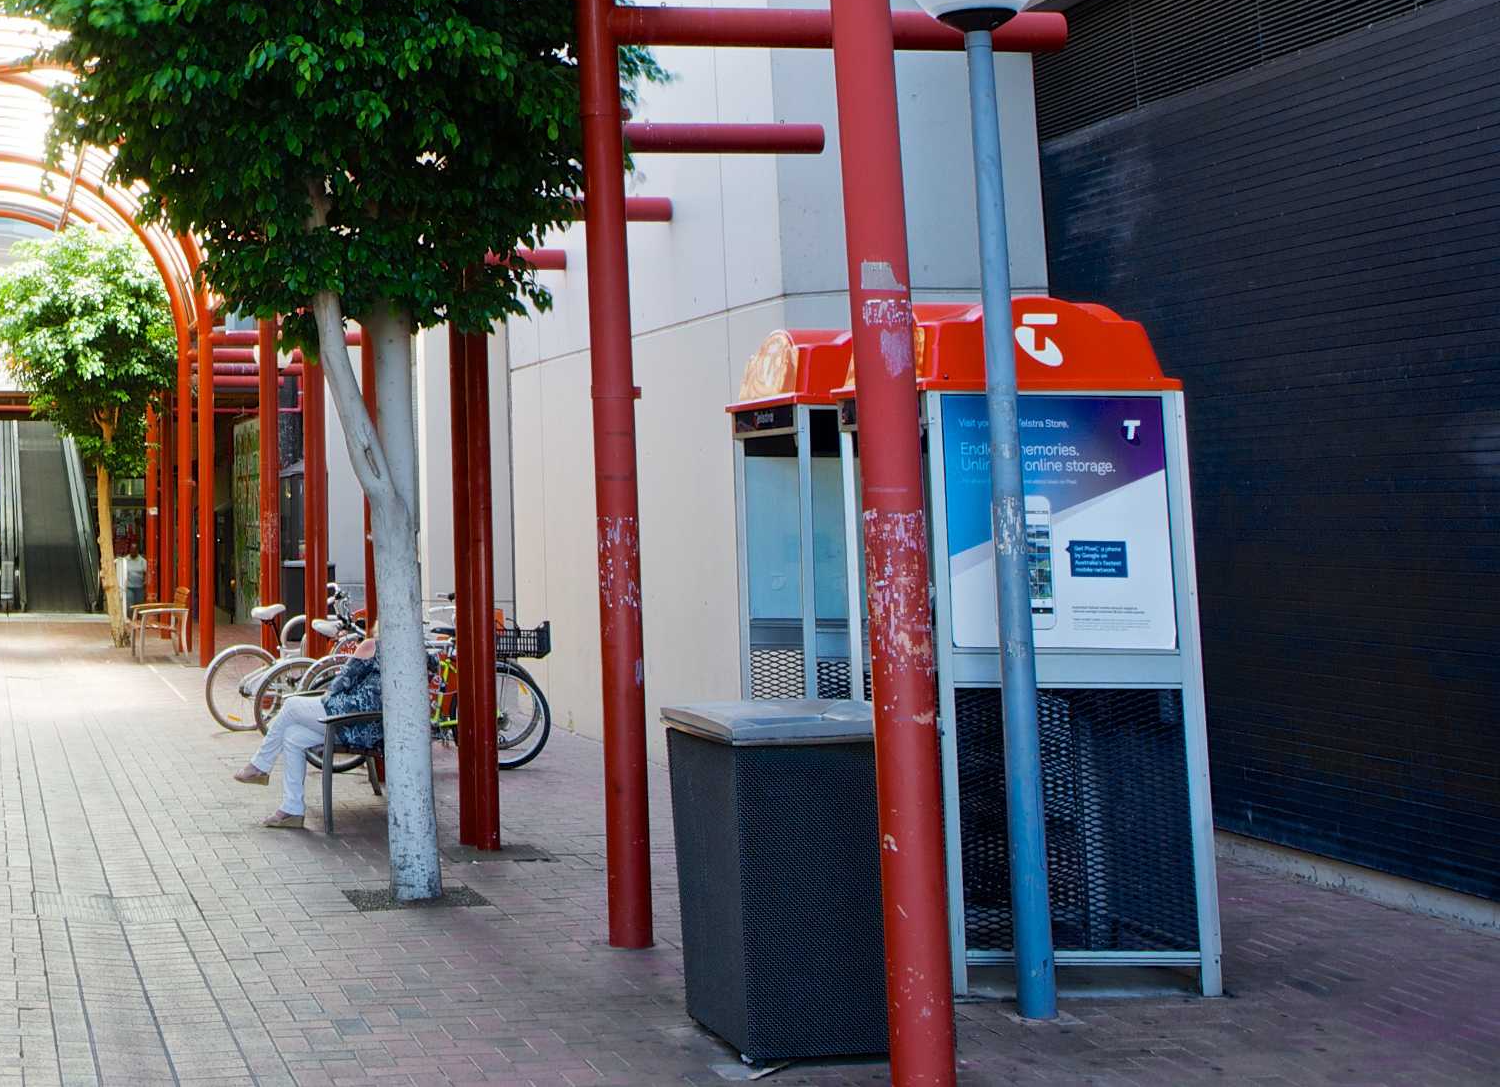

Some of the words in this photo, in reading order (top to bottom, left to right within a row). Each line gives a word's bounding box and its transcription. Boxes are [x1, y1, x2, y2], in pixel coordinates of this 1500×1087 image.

[959, 418, 976, 428] Visit
[1045, 418, 1069, 429] Store.
[960, 442, 991, 456] Endl
[1025, 459, 1062, 473] online
[1065, 460, 1117, 475] storage.
